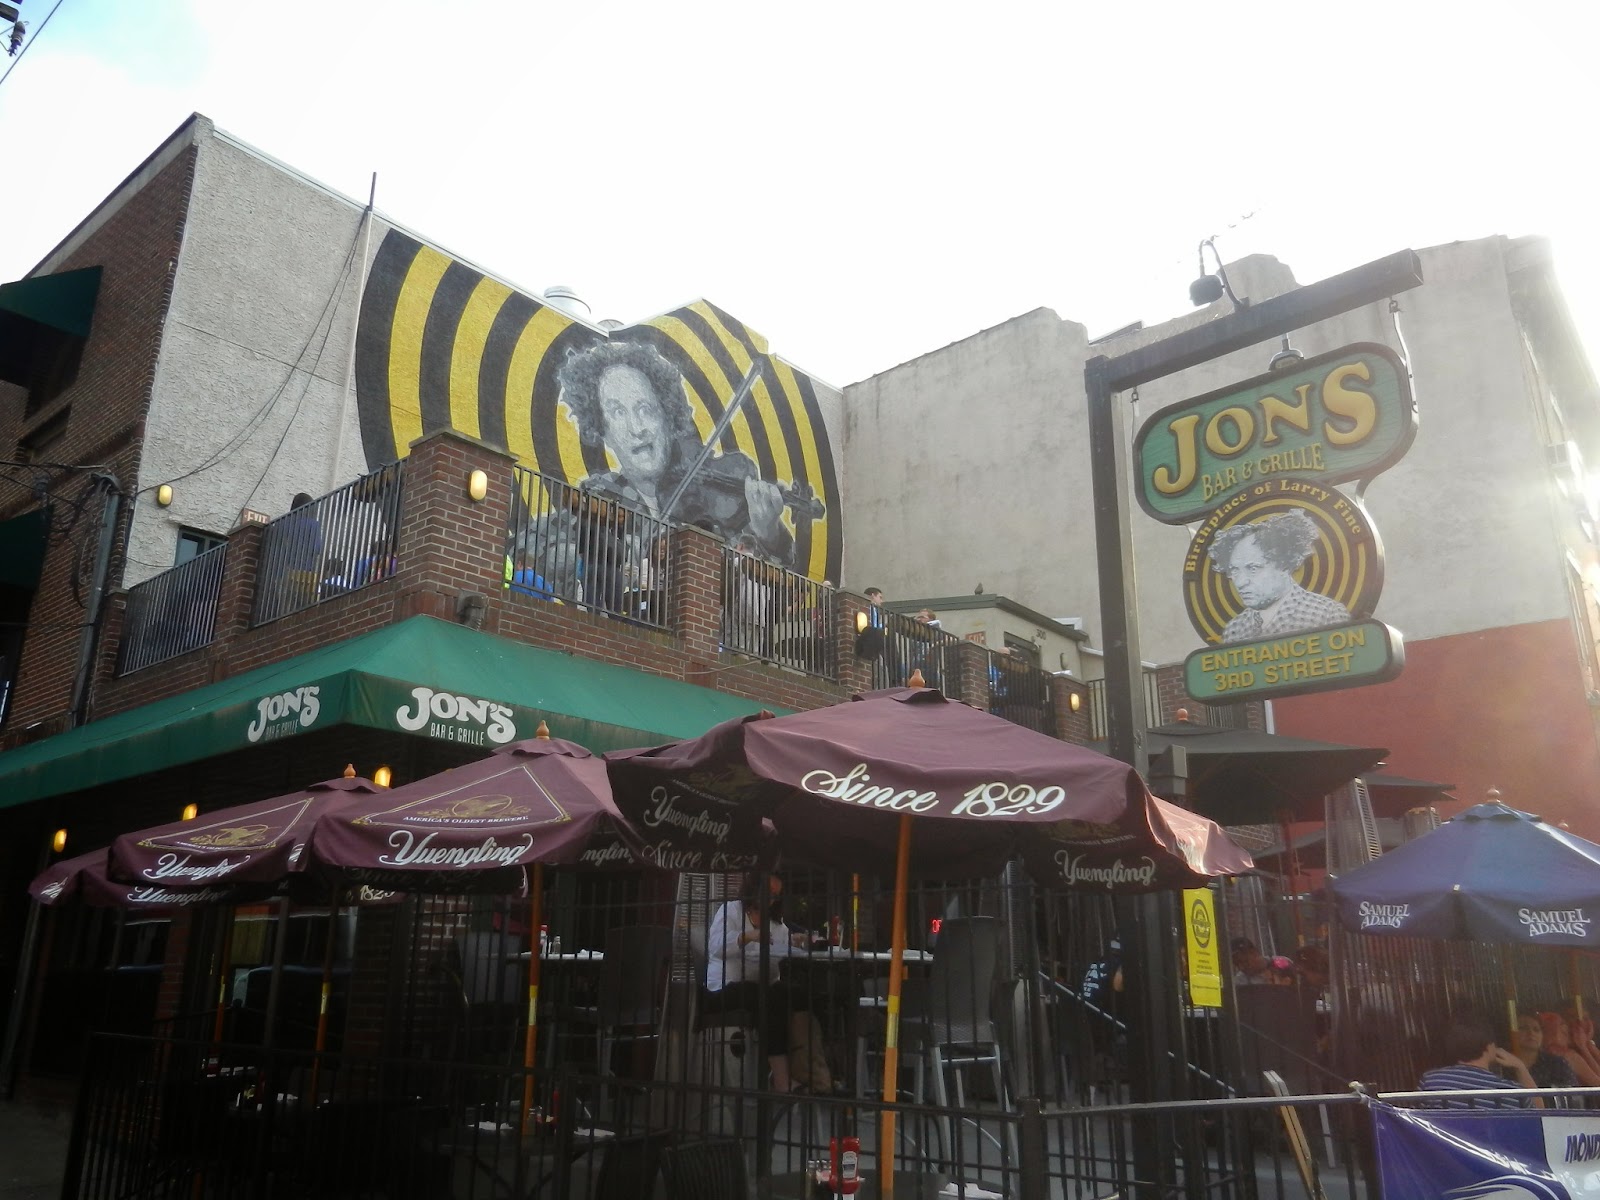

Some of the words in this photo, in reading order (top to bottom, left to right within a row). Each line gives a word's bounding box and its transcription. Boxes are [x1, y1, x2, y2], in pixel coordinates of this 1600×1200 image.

[1202, 466, 1238, 501] BAR
[1242, 460, 1254, 480] &
[1258, 443, 1326, 474] GRILLE
[1185, 492, 1248, 572] Birthplace
[1254, 481, 1272, 497] of
[1280, 479, 1331, 502] Larry
[1333, 498, 1361, 535] Fine
[1201, 634, 1322, 673] ENTRANCE
[1328, 627, 1366, 651] ON
[1215, 671, 1255, 693] 3RD
[1263, 652, 1354, 684] STREET
[248, 686, 320, 743] JON'S
[396, 687, 517, 744] JON'S
[430, 722, 446, 740] BAR
[448, 725, 454, 741] &
[457, 727, 485, 746] GRILLE
[801, 763, 940, 812] Since
[951, 781, 1066, 817] 1829
[643, 786, 733, 844] Yuengling
[379, 829, 534, 868] Yuengling
[1054, 849, 1157, 889] Yuengling
[1358, 900, 1411, 918] SAMUEL
[1360, 915, 1405, 931] ADAMS
[1517, 908, 1591, 925] SAMUEL
[1528, 922, 1587, 938] ADAMS
